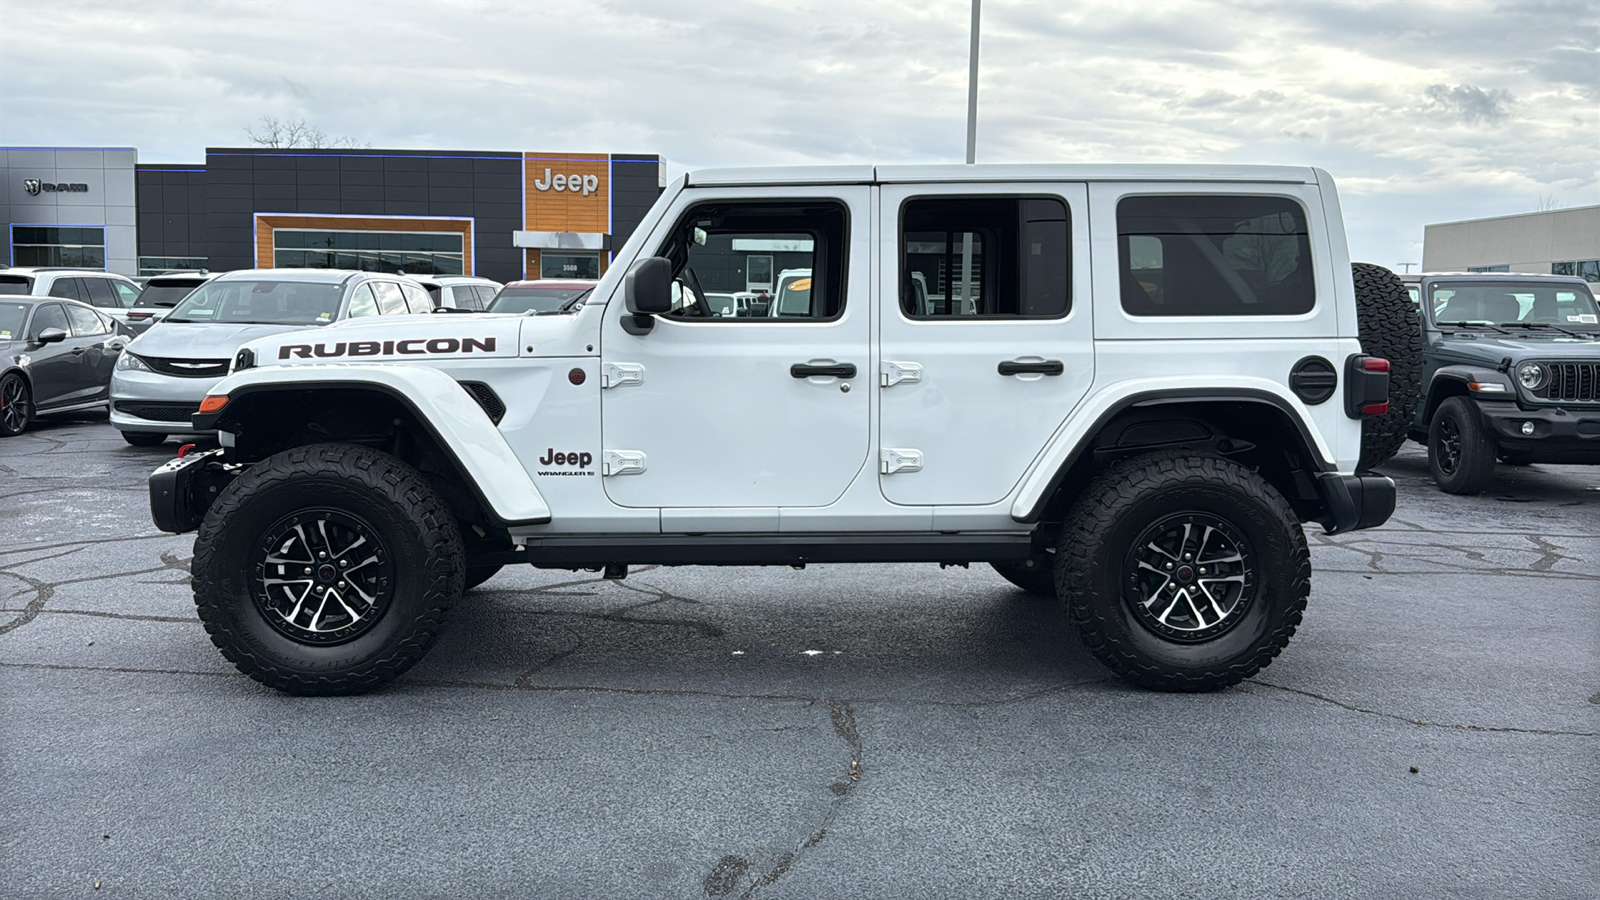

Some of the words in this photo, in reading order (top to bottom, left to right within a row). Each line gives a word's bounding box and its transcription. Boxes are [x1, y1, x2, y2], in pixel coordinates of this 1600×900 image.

[42, 183, 88, 192] RAM
[534, 168, 598, 196] Jeep
[278, 337, 496, 360] RUBICON
[539, 448, 592, 468] Jeep
